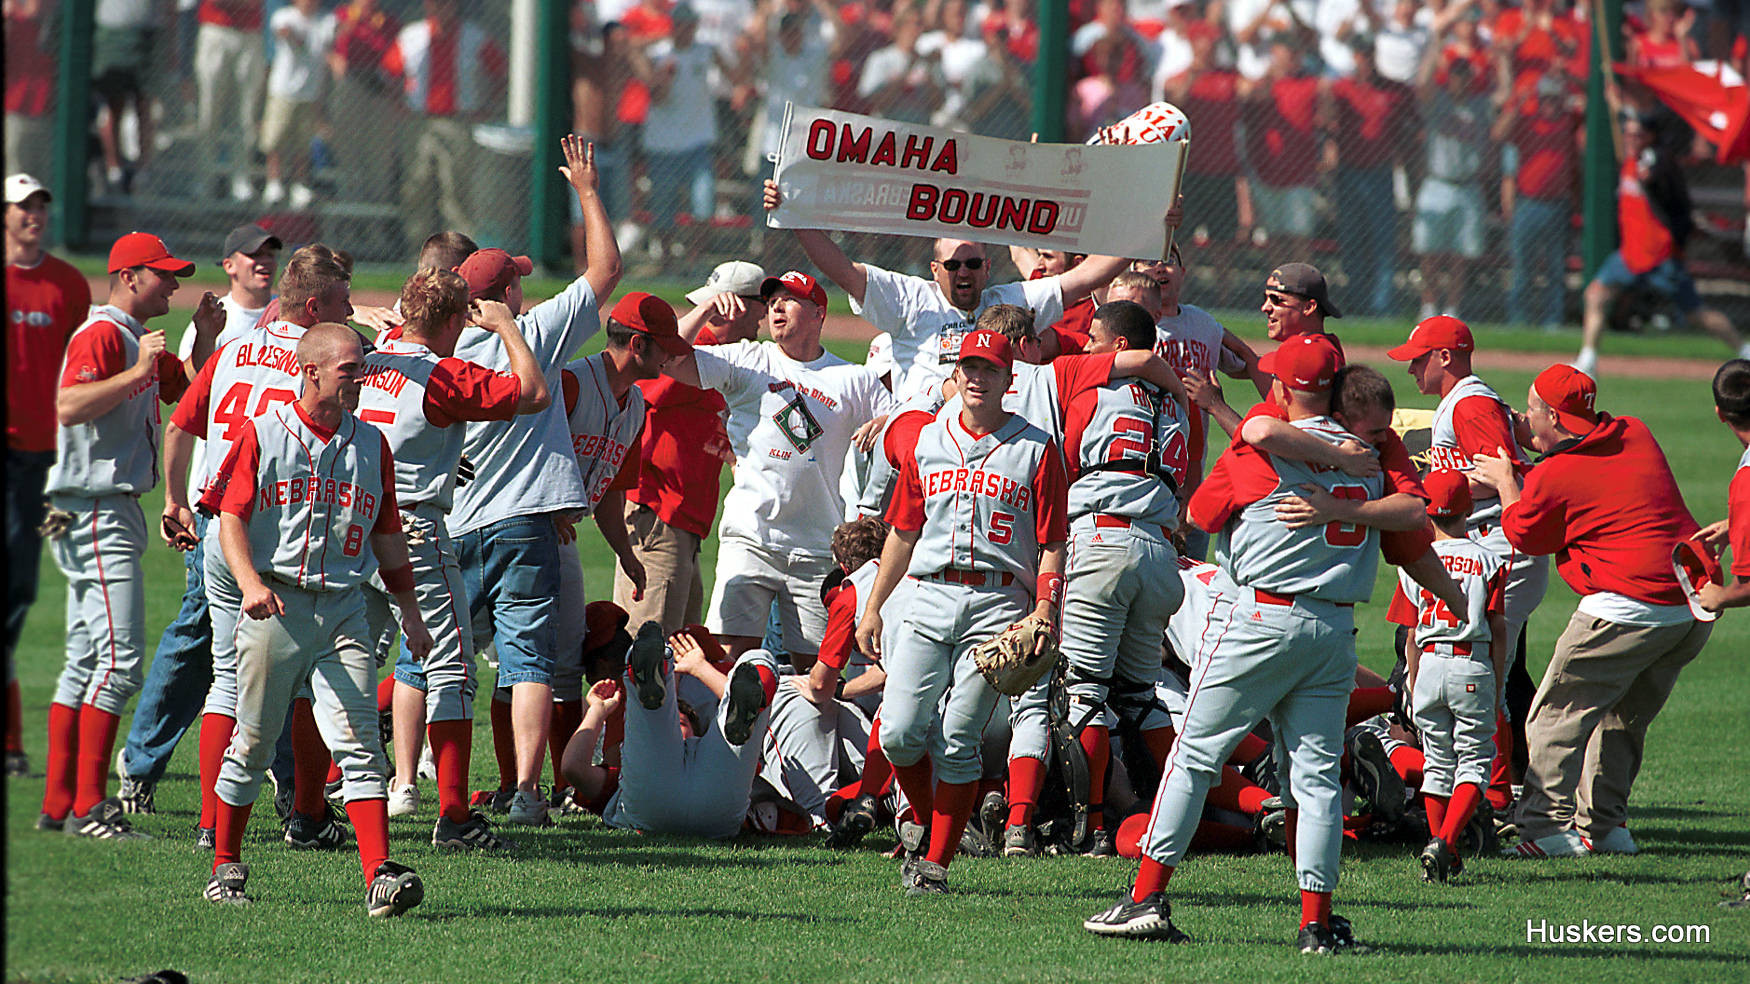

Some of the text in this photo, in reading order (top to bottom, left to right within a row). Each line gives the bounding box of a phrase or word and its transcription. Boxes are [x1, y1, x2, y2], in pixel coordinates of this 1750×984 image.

[807, 119, 957, 174] OMAHA
[906, 183, 1059, 234] BOUND
[976, 333, 992, 347] N
[1128, 383, 1179, 422] RIRA
[571, 433, 628, 467] EBRAS
[768, 448, 793, 459] KLIN
[1107, 416, 1189, 488] 24
[259, 476, 376, 520] NEBRASKA
[342, 523, 364, 558] 8
[987, 510, 1017, 546] 5
[1440, 555, 1483, 577] RSON
